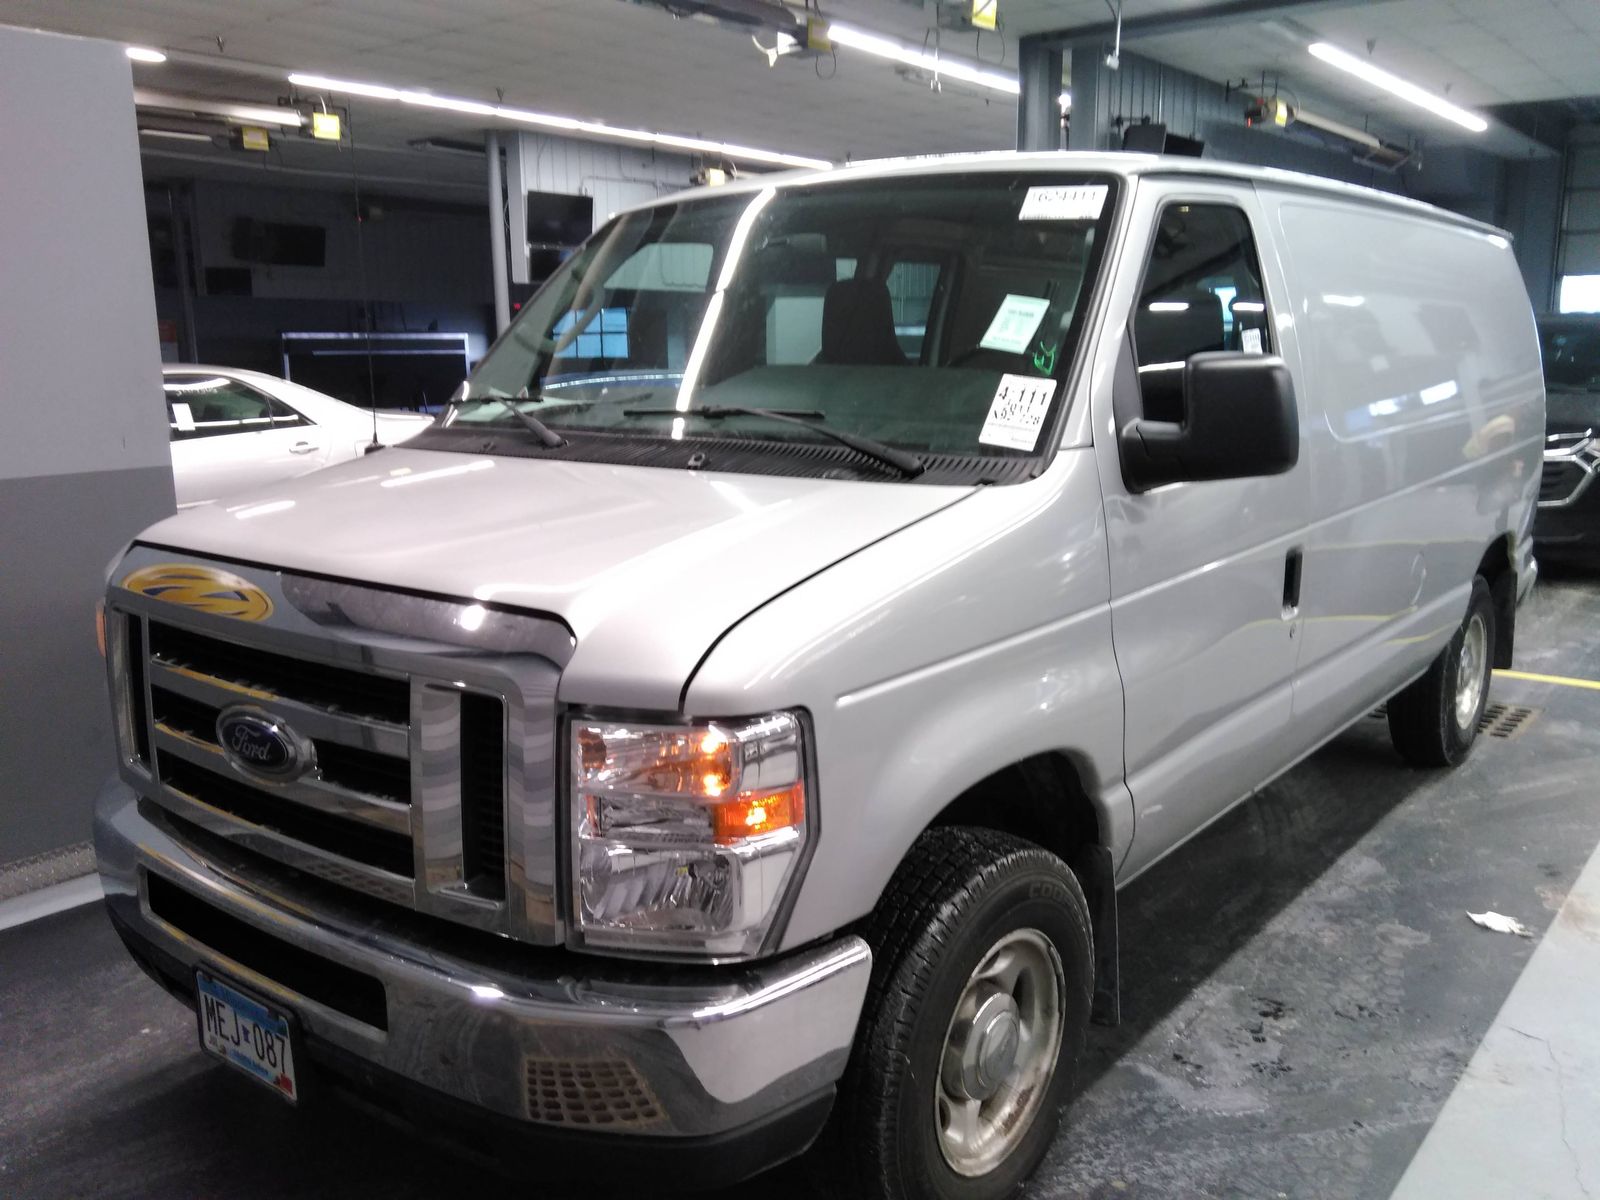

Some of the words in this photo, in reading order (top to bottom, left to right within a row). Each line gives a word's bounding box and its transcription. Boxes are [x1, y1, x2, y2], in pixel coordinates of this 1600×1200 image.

[231, 723, 273, 761] Ford
[203, 993, 241, 1046] MEJ
[252, 1022, 286, 1075] 087
